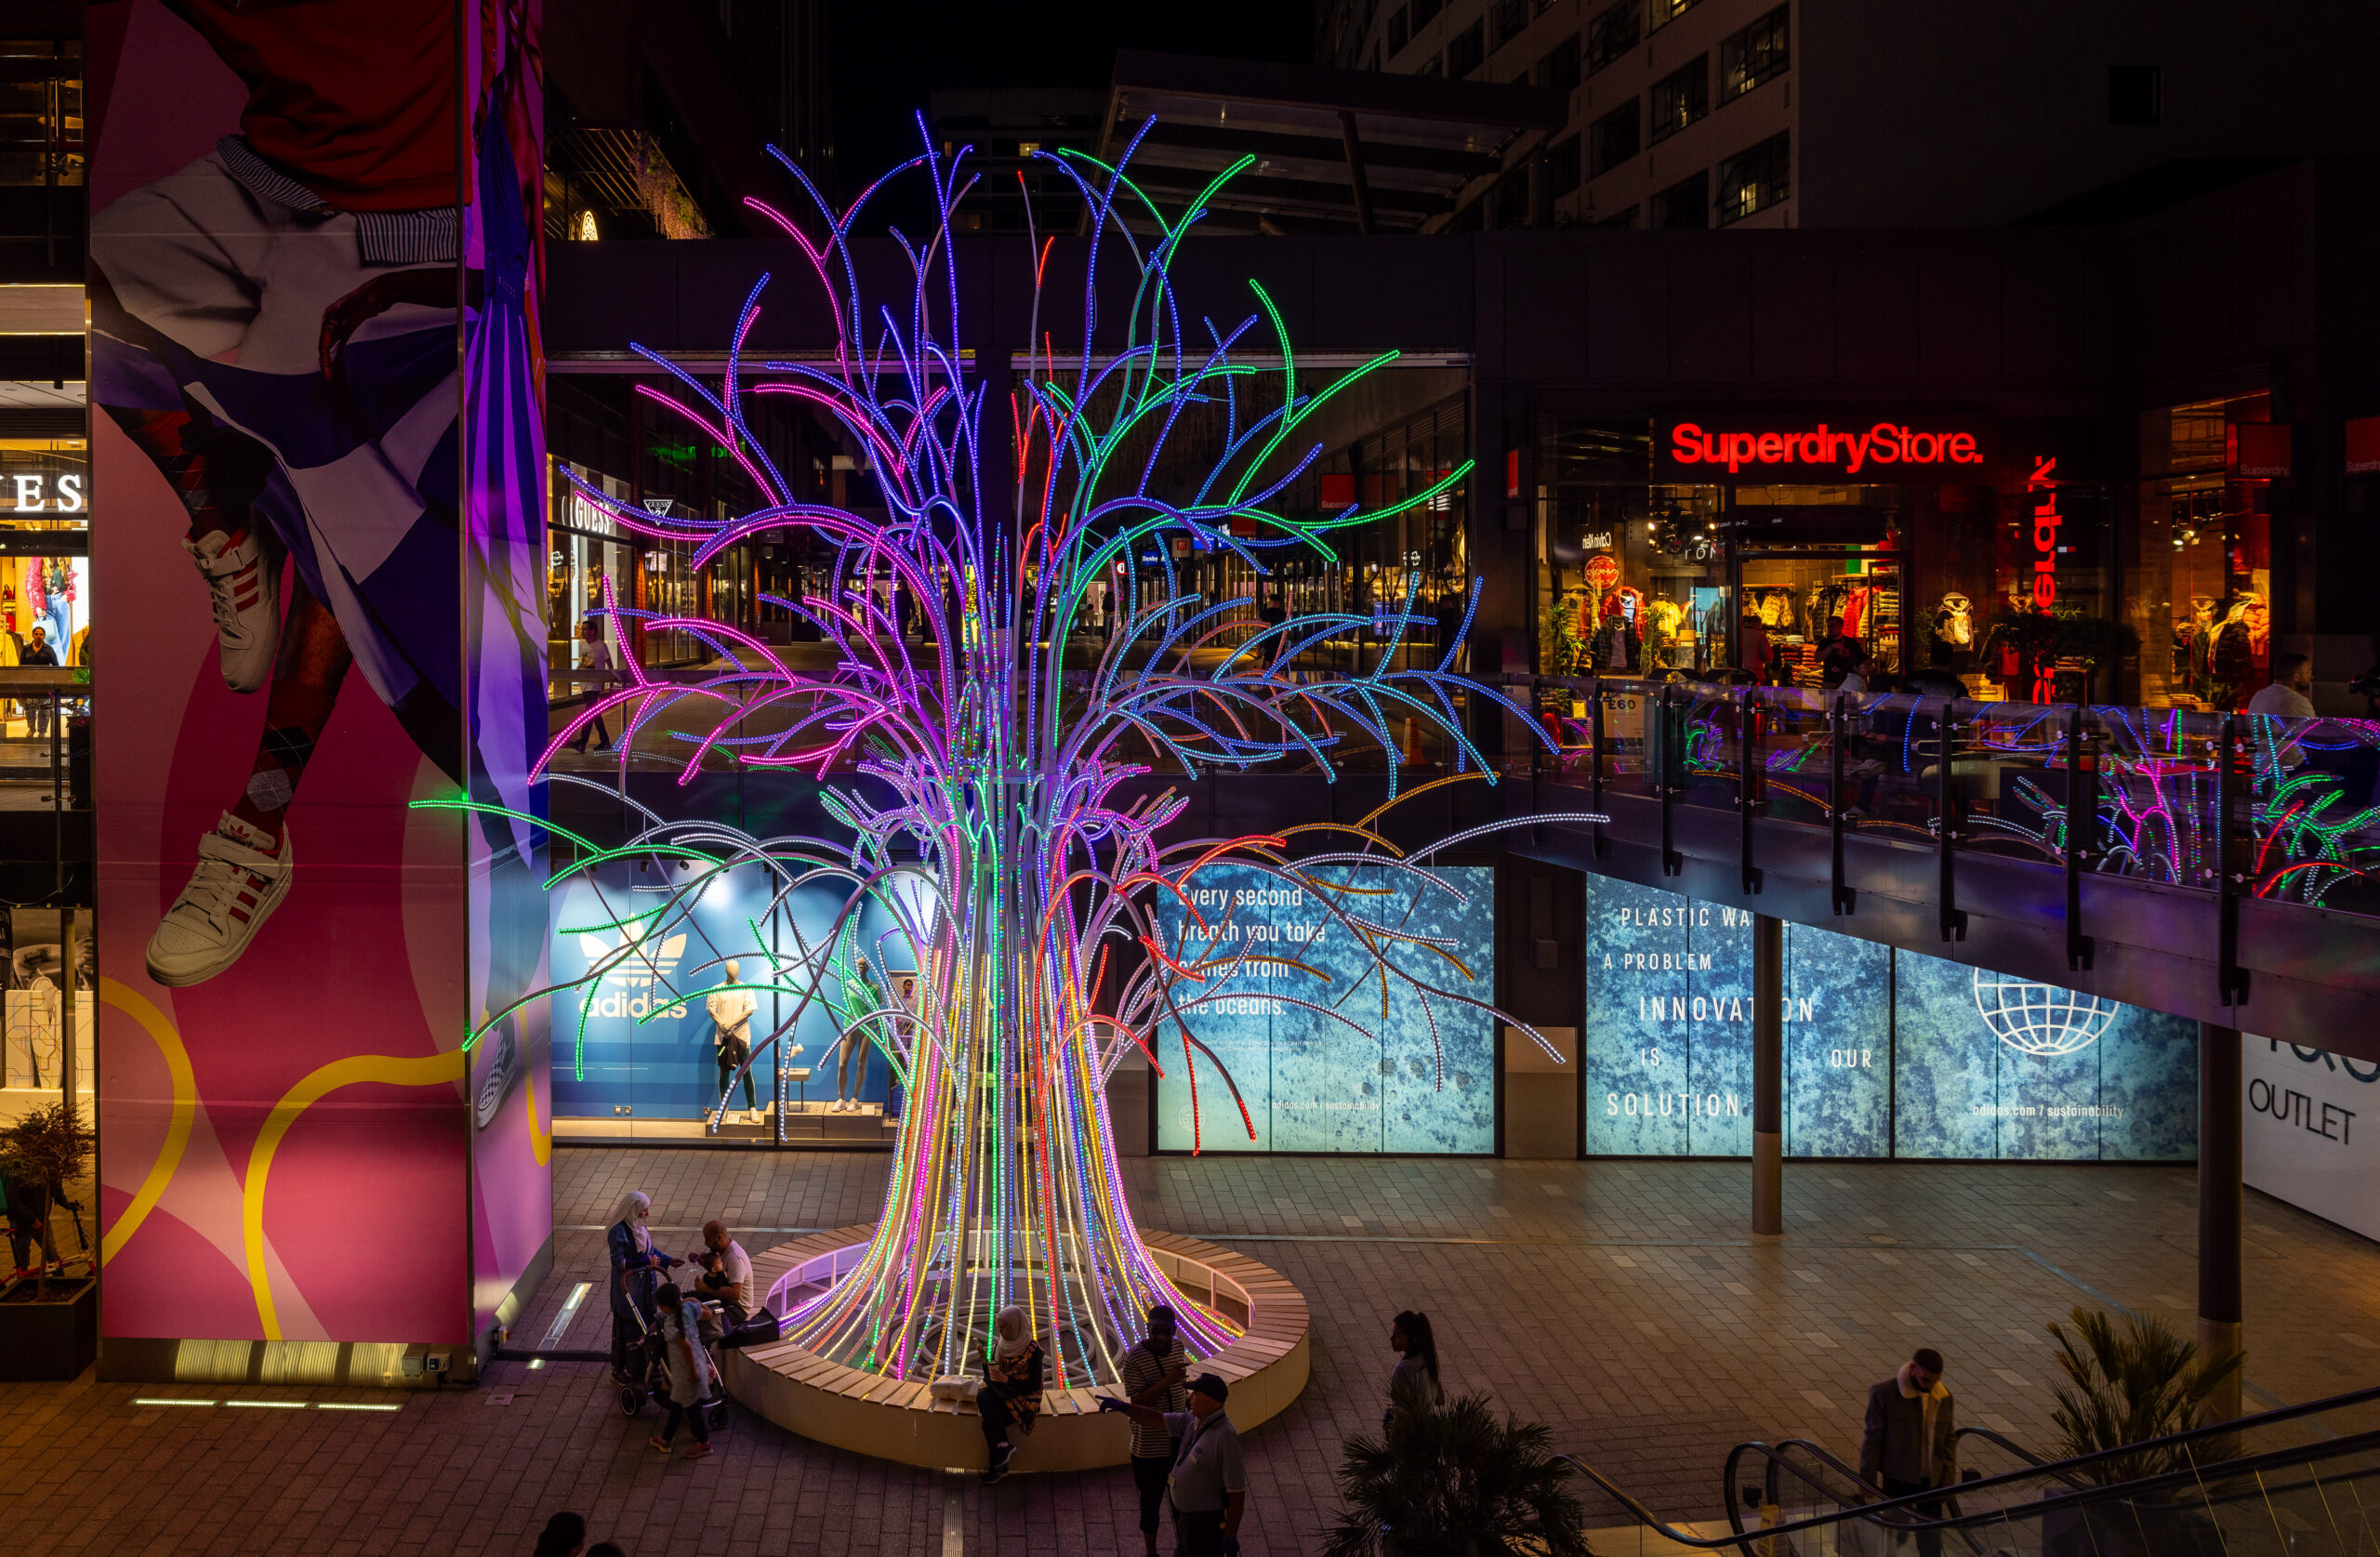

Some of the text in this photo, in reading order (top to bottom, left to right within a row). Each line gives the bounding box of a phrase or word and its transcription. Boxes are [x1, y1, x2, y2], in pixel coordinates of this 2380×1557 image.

[1672, 423, 1983, 473] SuperdryStore.
[0, 474, 83, 512] ES
[1178, 884, 1302, 910] Every second
[1621, 907, 1710, 927] PLASTIC
[1178, 920, 1238, 942] breath
[1286, 920, 1326, 942] take
[1604, 953, 1712, 970] A PROBLEM
[578, 992, 687, 1019] adidas
[1215, 997, 1287, 1015] oceans.
[1640, 996, 1813, 1023] INNOVATON
[1641, 1048, 1872, 1068] IS OUR
[1326, 1101, 1381, 1112] sustainability
[1606, 1092, 1739, 1116] SOLUTION
[1973, 1104, 2036, 1116] adidas.com
[2047, 1104, 2124, 1119] sustainability
[2249, 1078, 2357, 1145] OUTLET
